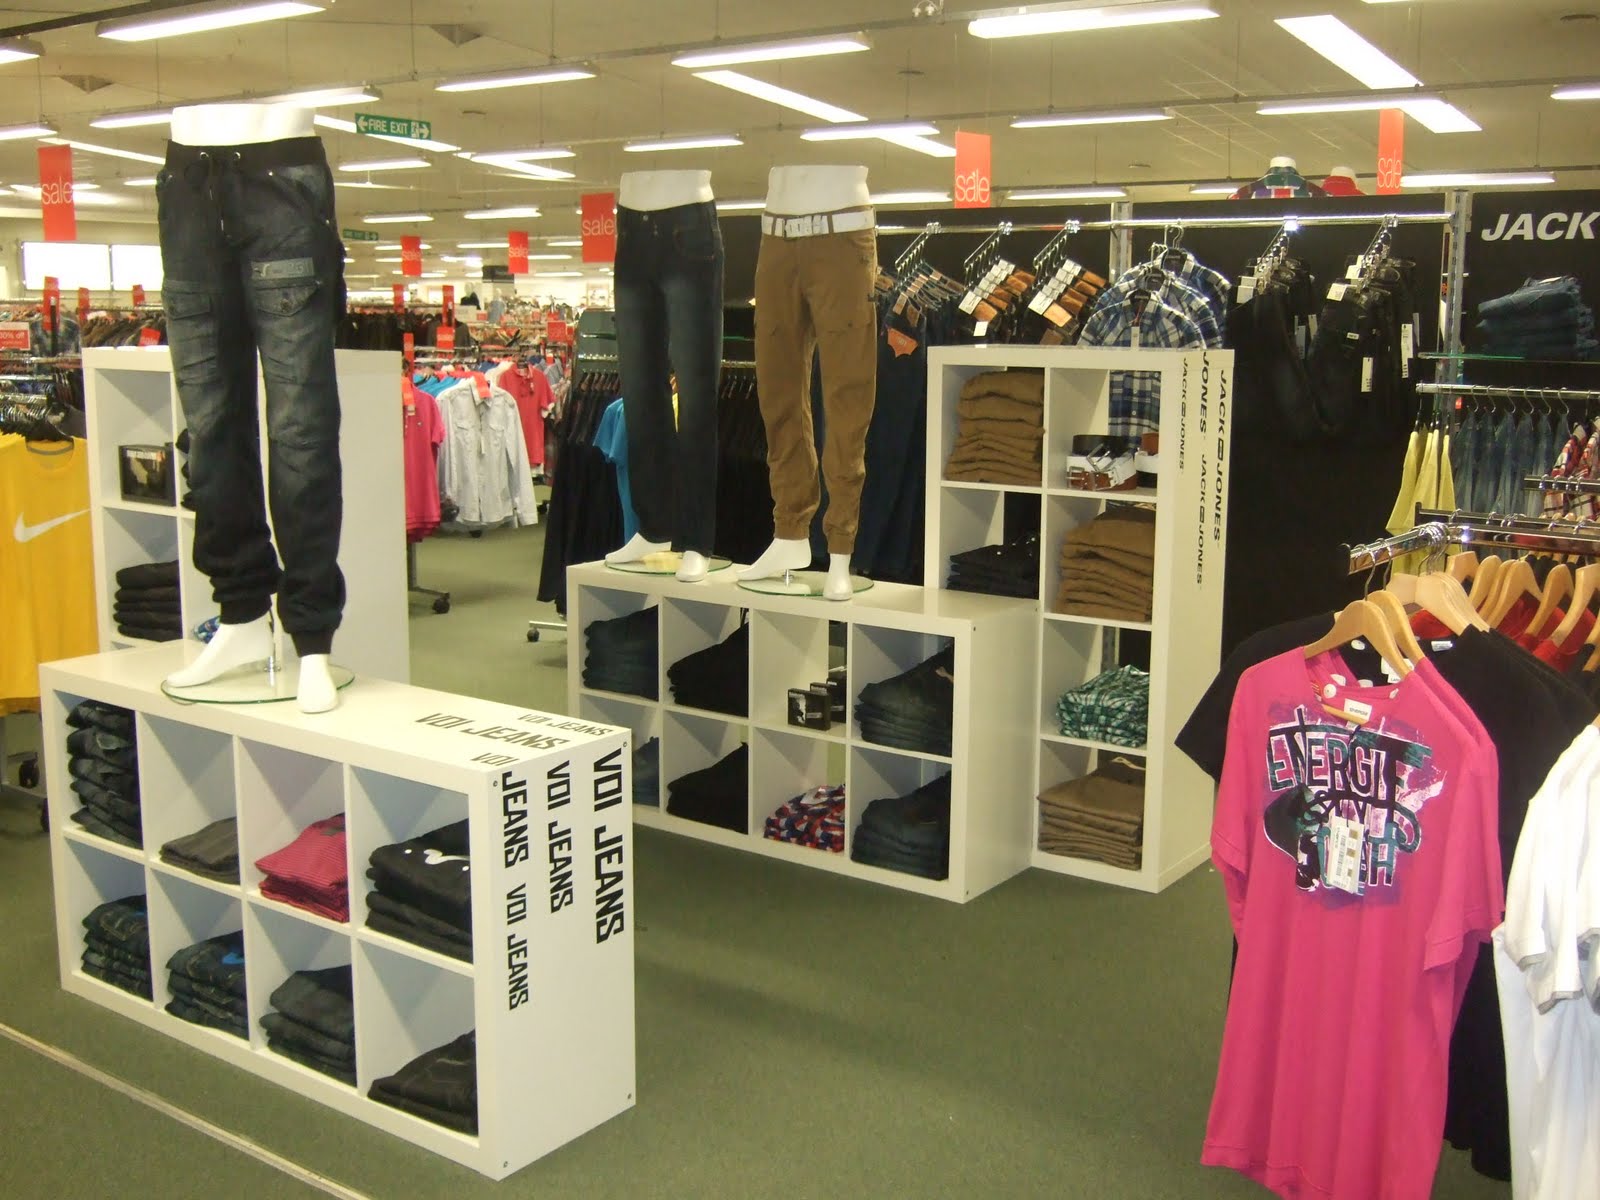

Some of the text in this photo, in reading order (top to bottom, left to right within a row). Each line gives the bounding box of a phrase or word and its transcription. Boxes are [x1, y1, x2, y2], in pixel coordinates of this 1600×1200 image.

[368, 119, 408, 134] FIRE EXIT
[41, 175, 73, 205] sale
[955, 168, 990, 203] sale
[582, 215, 614, 236] sale
[1481, 212, 1600, 241] JACK
[508, 244, 528, 258] sale
[1199, 351, 1209, 434] JONES
[1213, 369, 1227, 542] JACK JONES
[415, 712, 571, 750] VOI JEANS
[517, 713, 614, 737] VOI JEANS
[470, 752, 519, 766] VOI
[546, 760, 574, 914] VOI JEANS
[593, 747, 625, 944] VOI JEANS
[501, 770, 529, 1011] JEANS VOI JEANS
